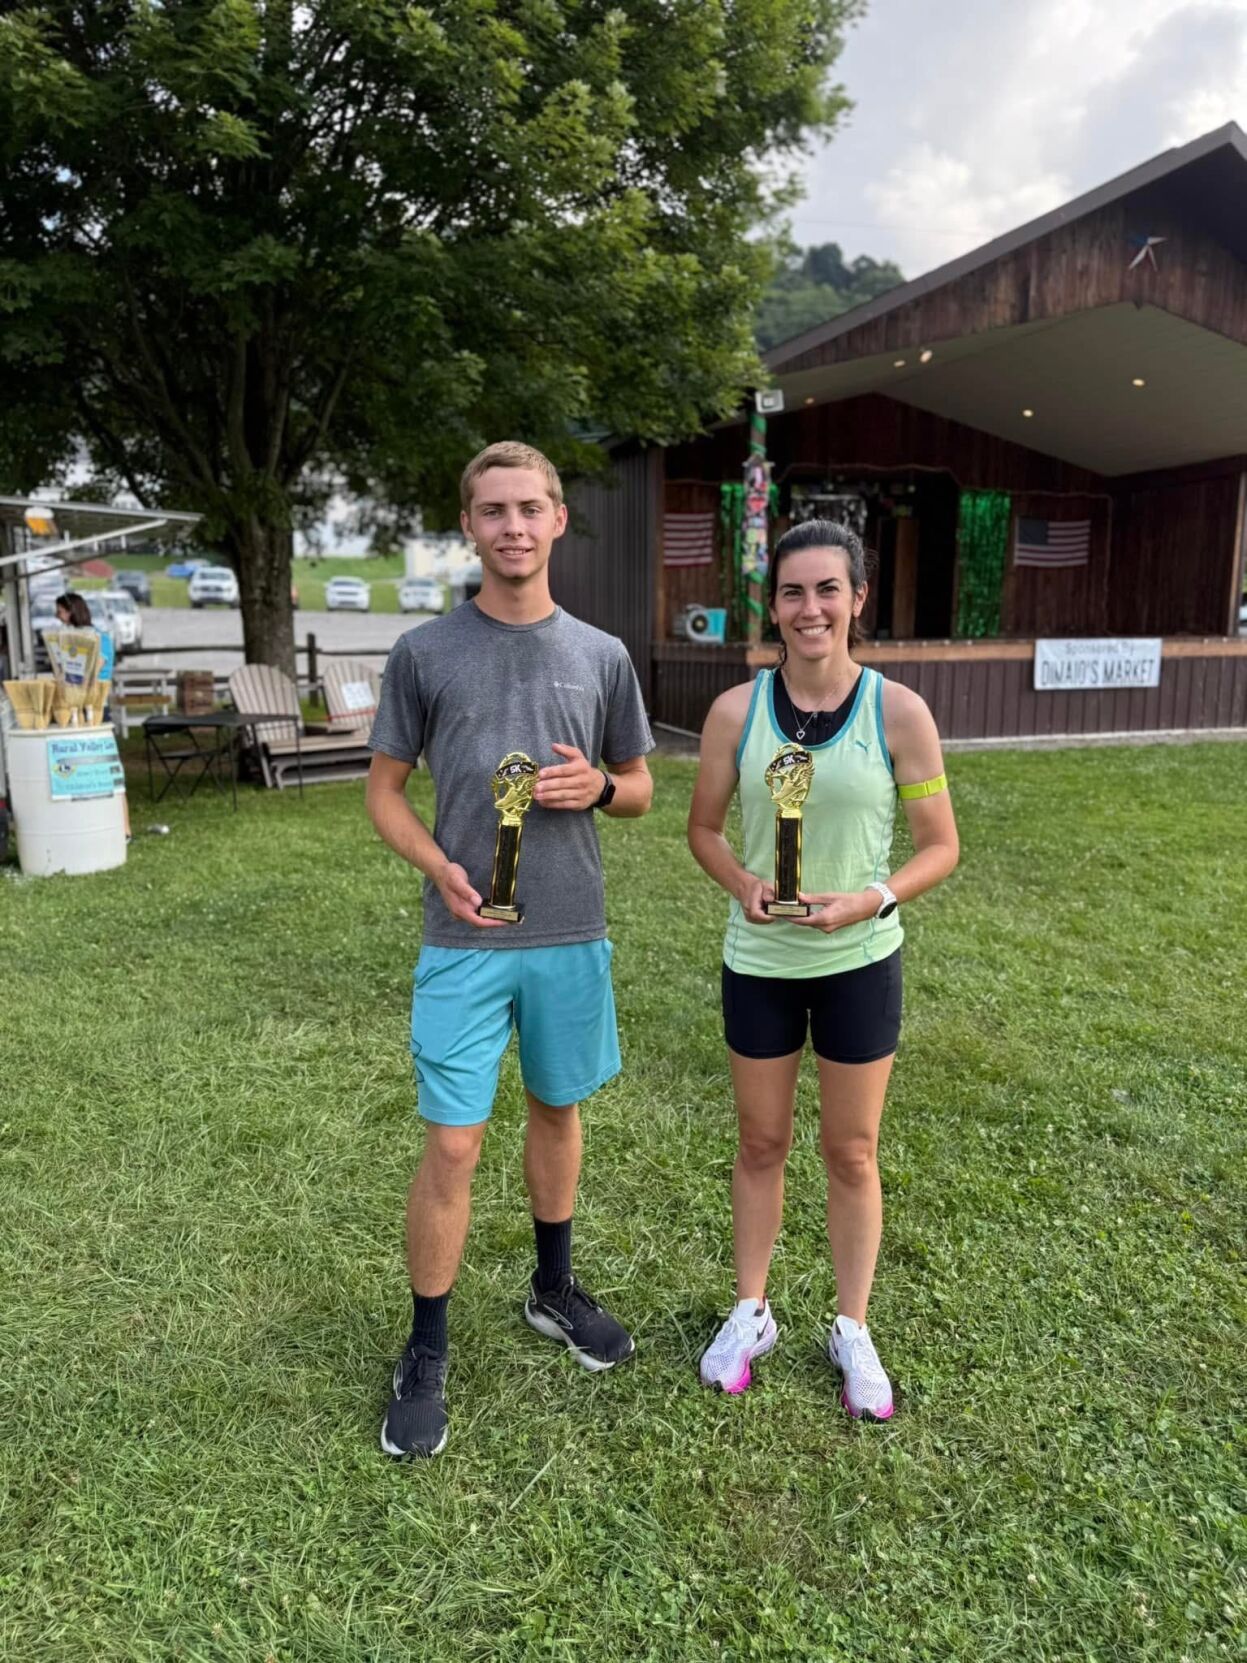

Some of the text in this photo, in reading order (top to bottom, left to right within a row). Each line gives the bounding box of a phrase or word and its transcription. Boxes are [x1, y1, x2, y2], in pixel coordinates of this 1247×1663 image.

[1103, 659, 1155, 684] MARKET
[783, 755, 795, 765] 5K
[510, 764, 521, 774] 5K
